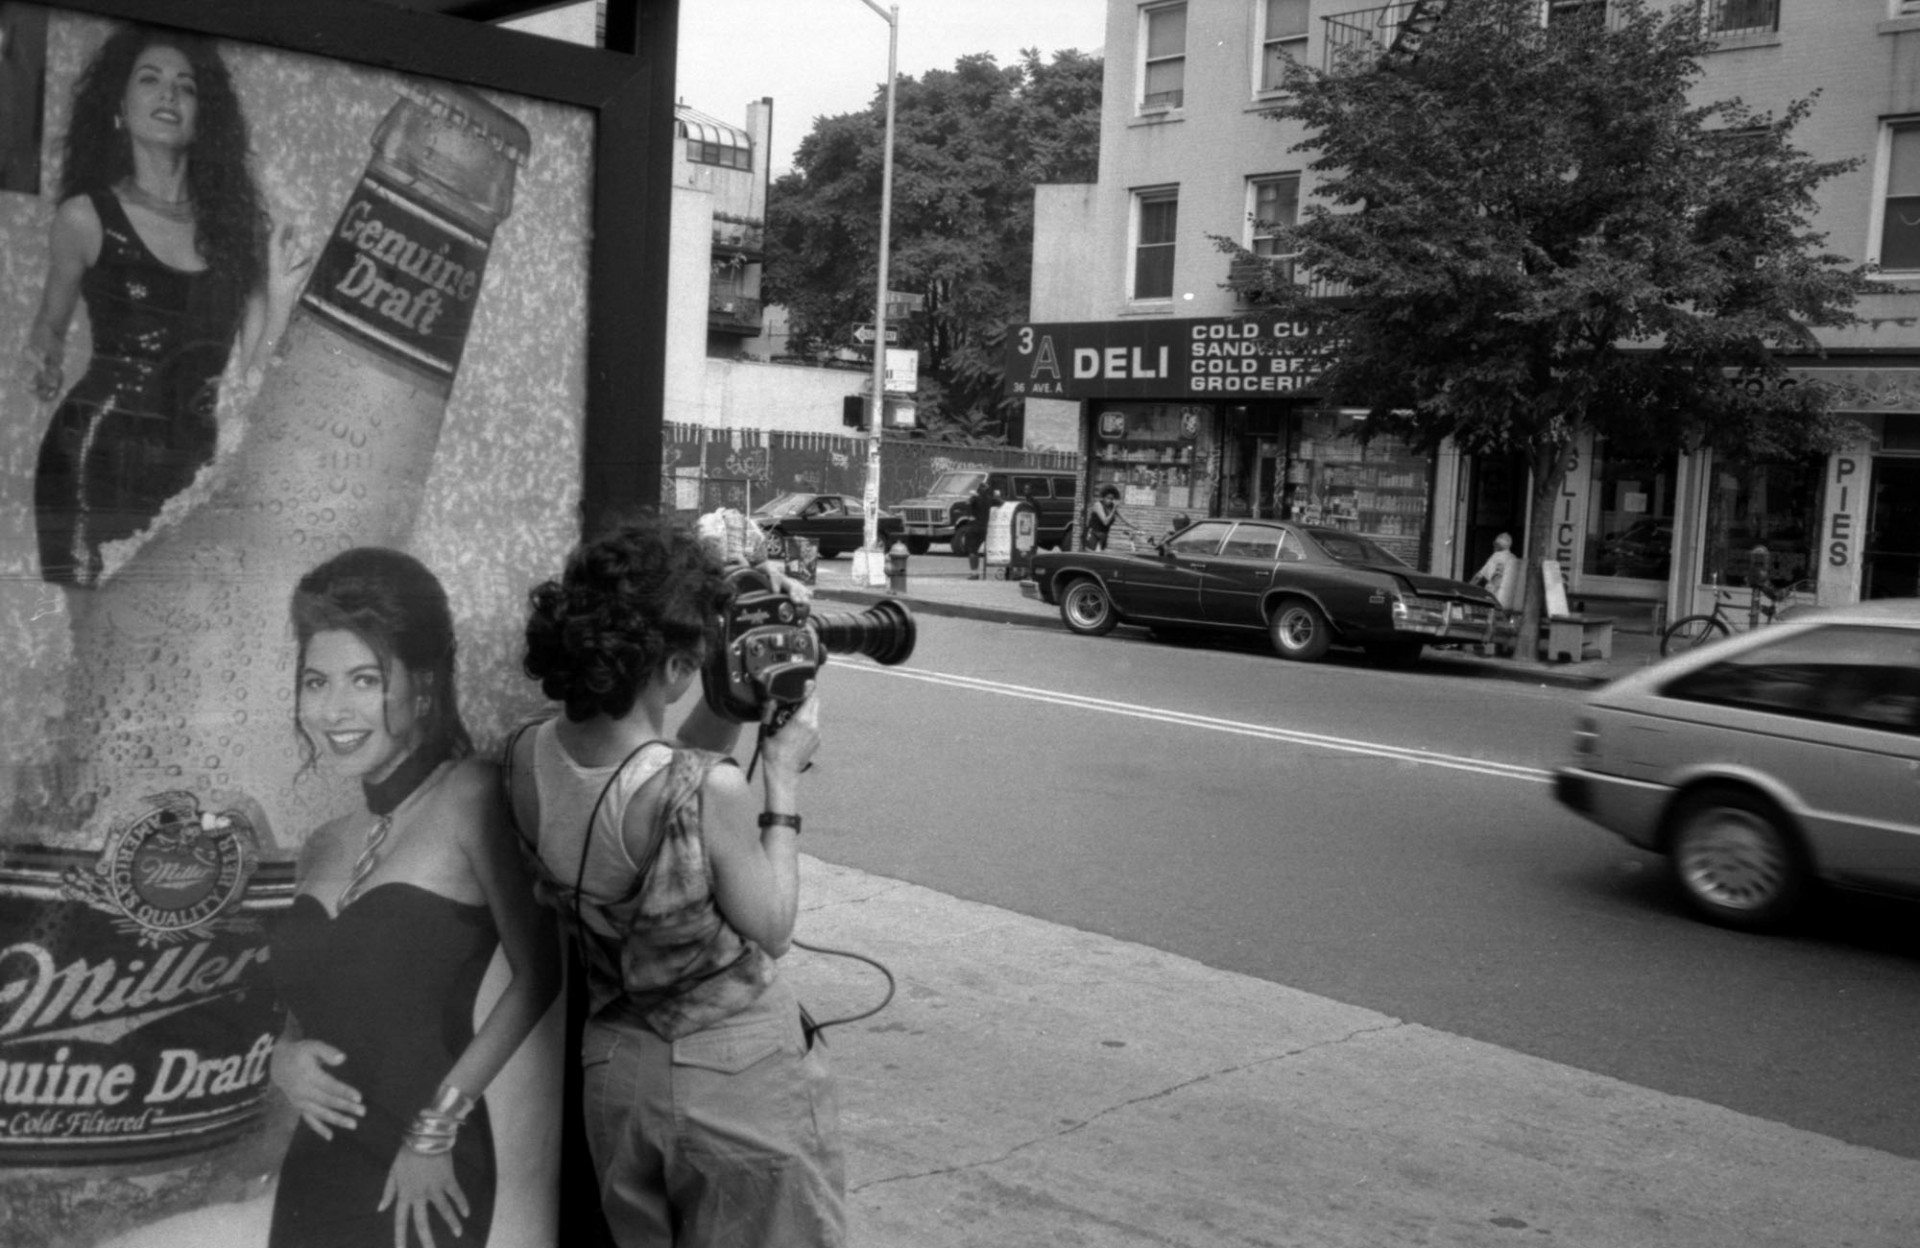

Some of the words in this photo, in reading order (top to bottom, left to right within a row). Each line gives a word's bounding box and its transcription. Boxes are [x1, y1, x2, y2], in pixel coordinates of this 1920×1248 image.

[340, 200, 476, 301] Genuine
[335, 253, 443, 335] Draft
[1191, 324, 1259, 339] COLD
[1074, 346, 1169, 379] DELI
[1191, 359, 1258, 373] COLD
[1013, 382, 1026, 393] 36
[1032, 382, 1053, 393] AVE.
[1055, 381, 1063, 393] A
[1191, 376, 1315, 391] GROCERI
[1829, 458, 1856, 567] PIES
[137, 887, 224, 926] QUALITY
[0, 942, 270, 1035] Miller
[144, 1033, 274, 1104] Draft
